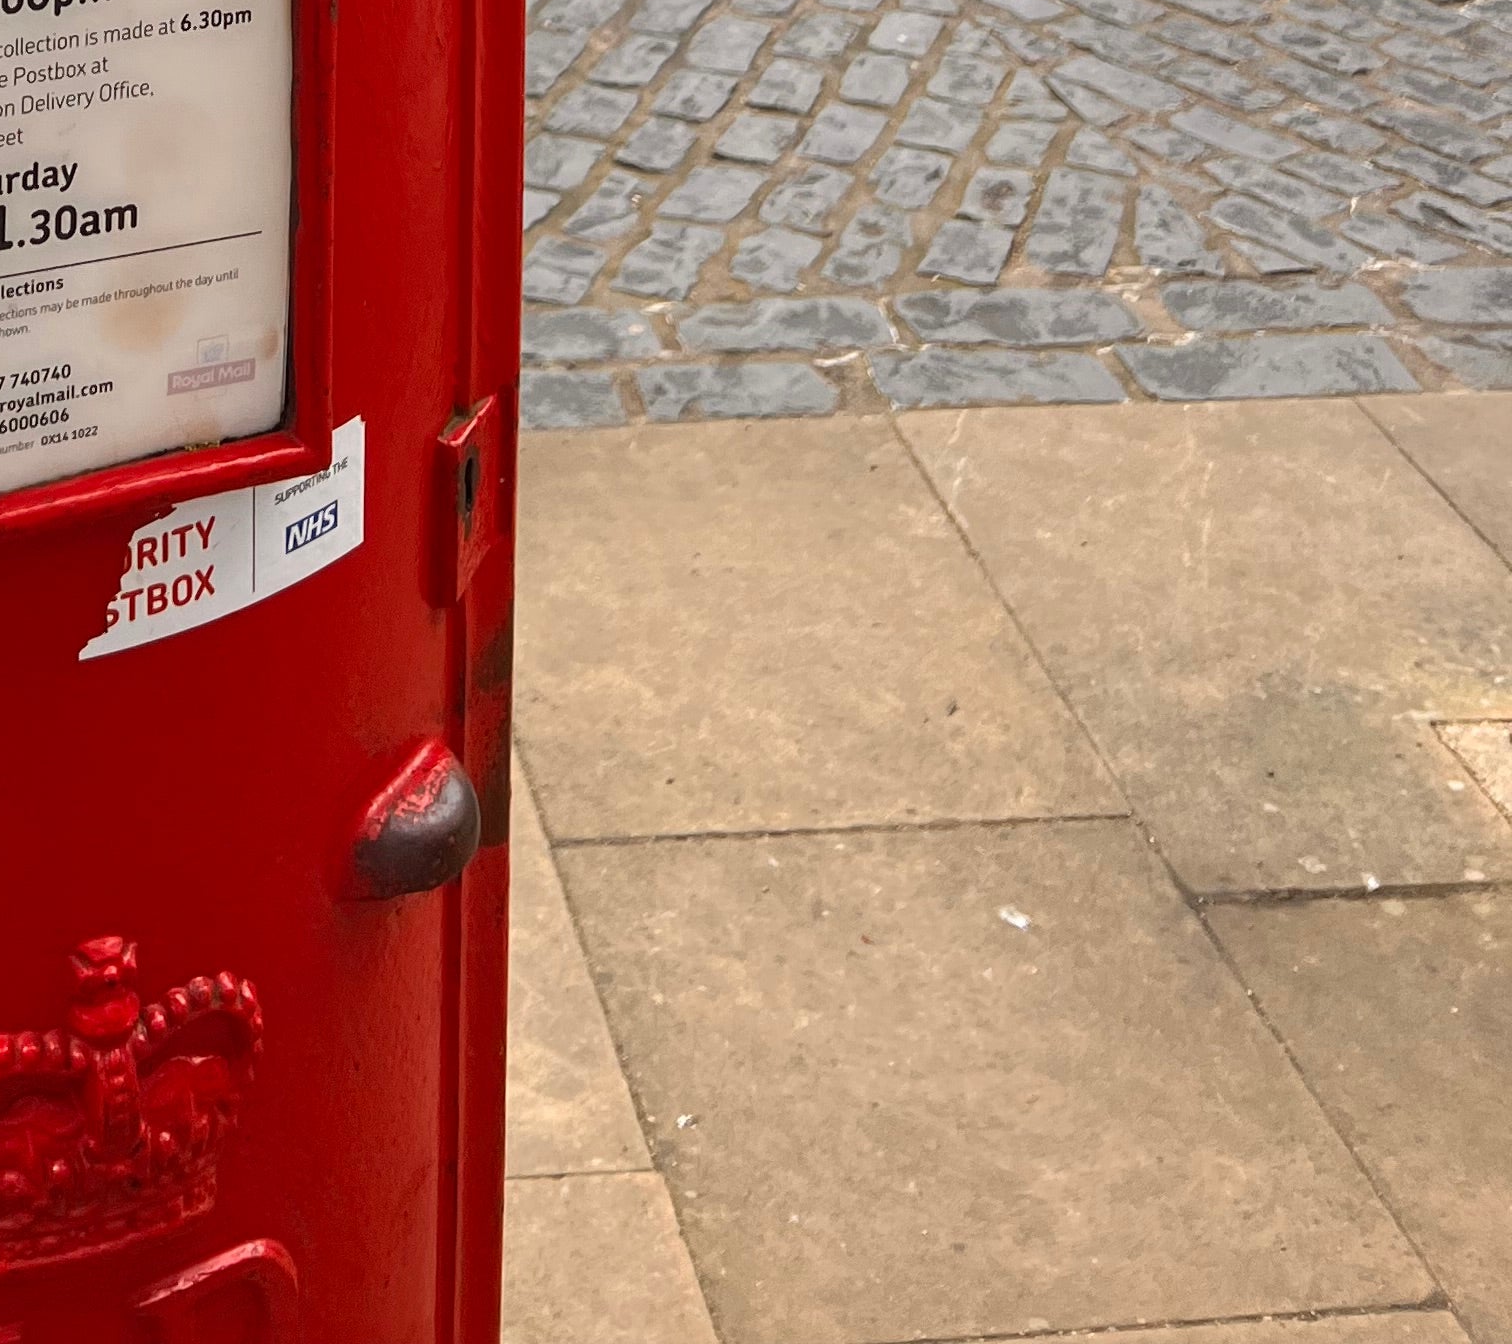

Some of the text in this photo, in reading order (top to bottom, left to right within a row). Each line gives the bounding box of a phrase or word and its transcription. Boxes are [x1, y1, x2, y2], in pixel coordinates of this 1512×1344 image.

[84, 31, 99, 47] is
[103, 21, 154, 44] made
[158, 18, 176, 36] at
[179, 8, 253, 33] 6.30pm
[13, 60, 87, 87] Postbox
[91, 56, 109, 75] at
[21, 88, 94, 116] Delivery
[39, 300, 65, 315] may
[65, 298, 80, 310] be
[81, 291, 113, 308] made
[113, 280, 174, 302] throughout
[175, 277, 193, 290] the
[194, 273, 215, 288] day
[215, 267, 240, 283] until
[9, 363, 72, 390] 740740
[171, 361, 251, 390] Royal Mail
[332, 455, 349, 475] THE
[286, 500, 337, 552] NHS
[124, 514, 216, 572] RITY
